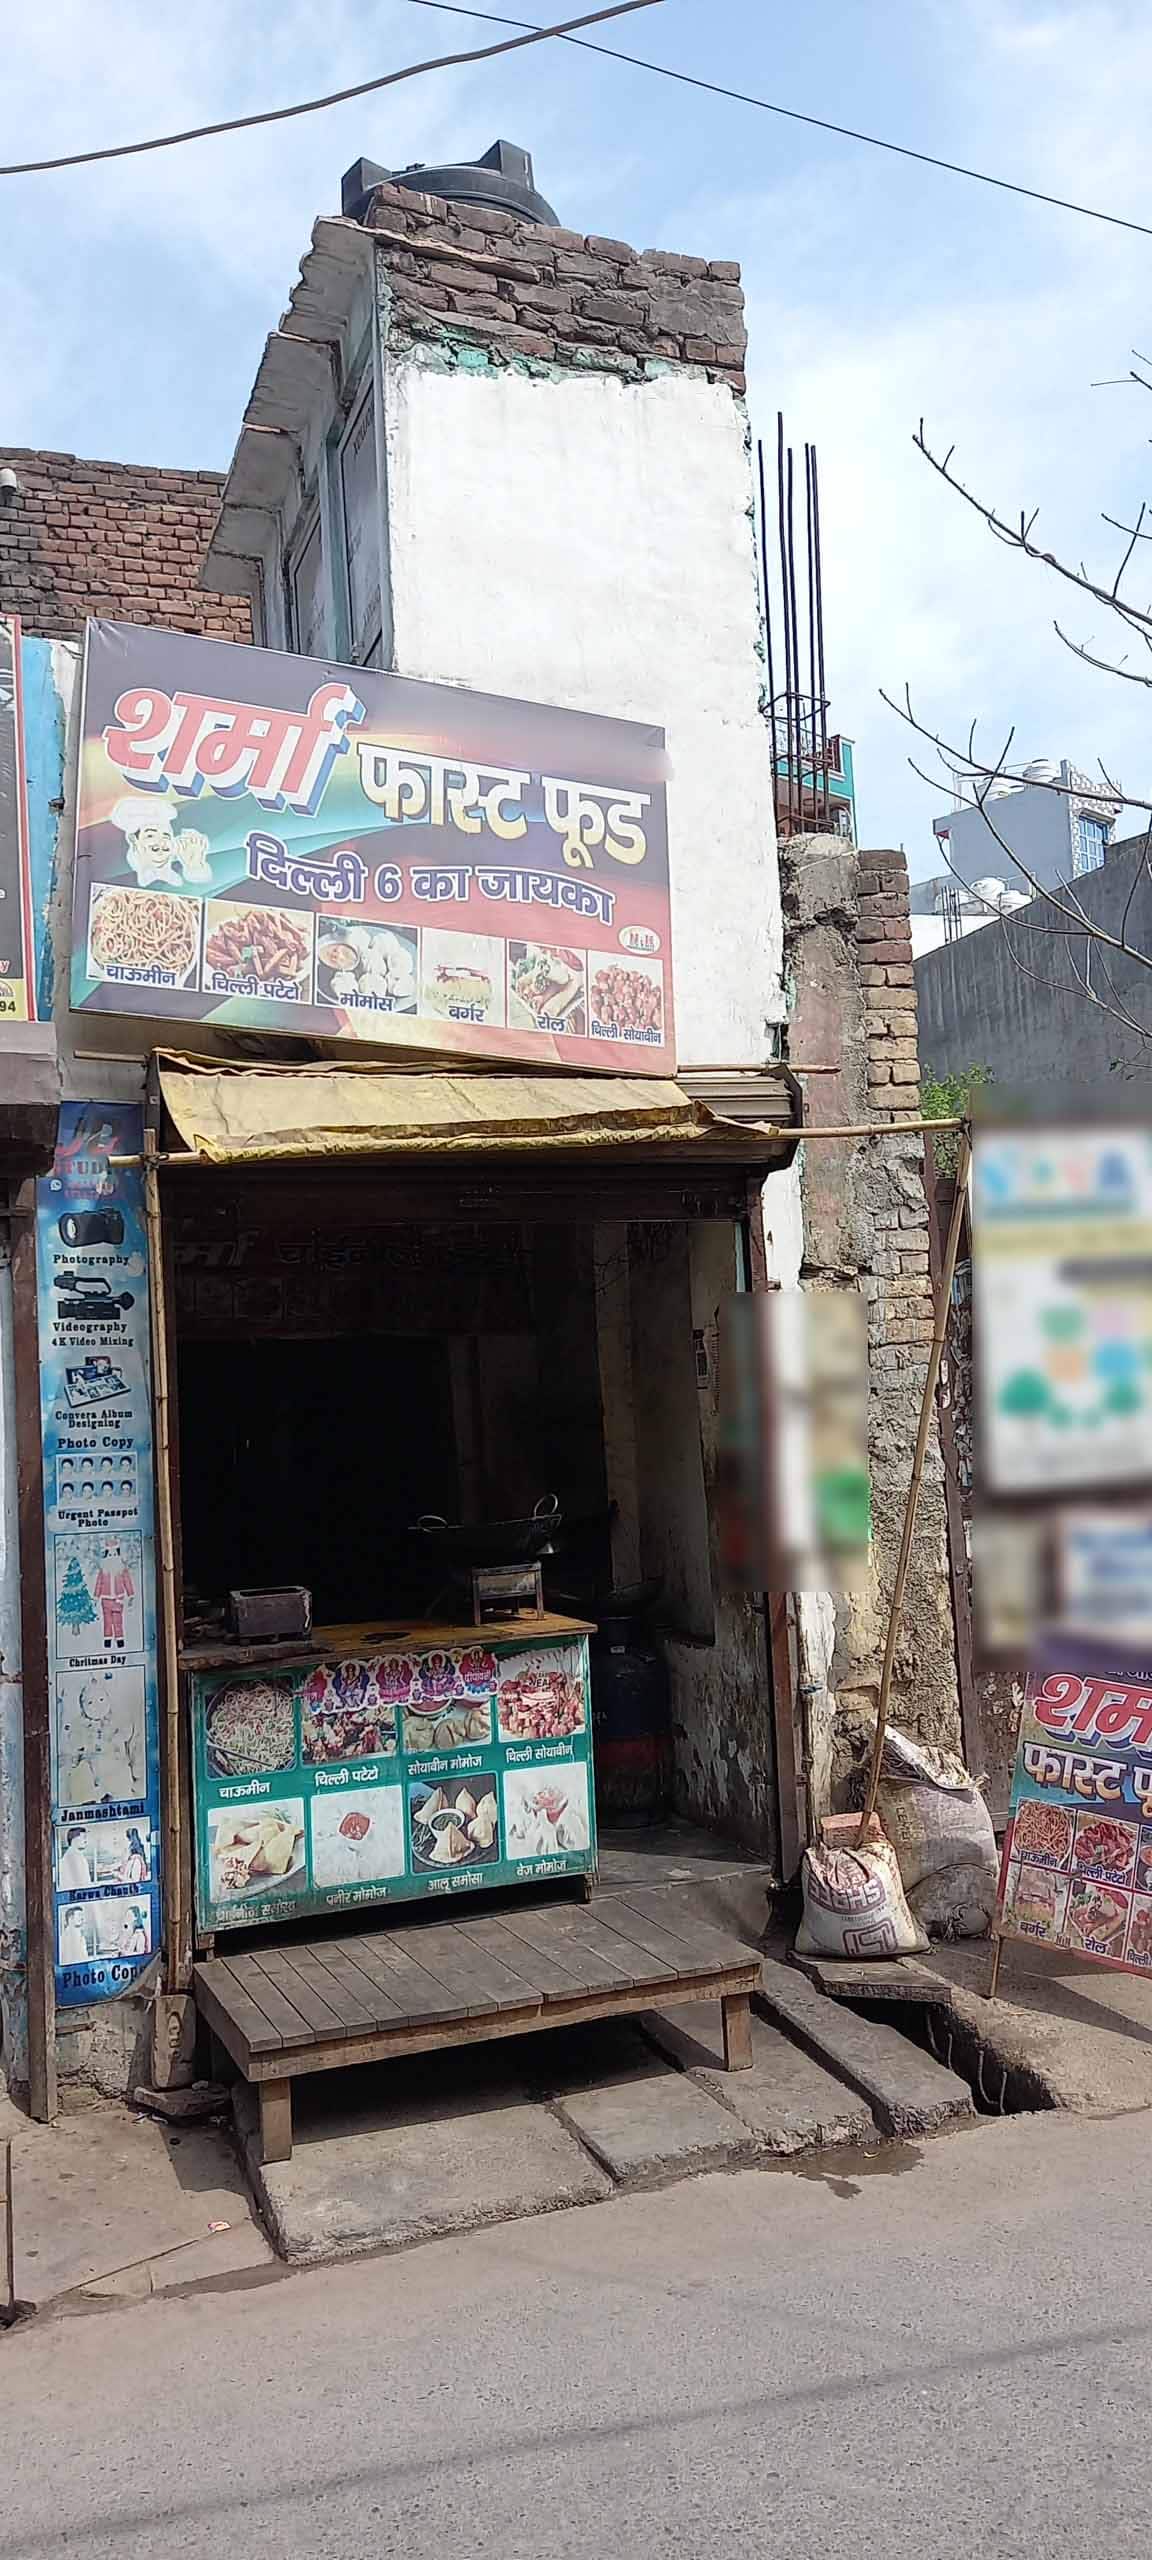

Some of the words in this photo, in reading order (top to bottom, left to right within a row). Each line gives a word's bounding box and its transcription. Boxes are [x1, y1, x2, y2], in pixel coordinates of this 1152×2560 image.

[102, 682, 365, 817] शर्मा
[357, 743, 532, 840] फास्ट
[541, 776, 651, 868] फूड
[247, 832, 367, 901] दिल्ली
[374, 865, 403, 902] 6
[411, 866, 471, 901] का
[477, 866, 614, 924] जायका
[106, 964, 176, 987] चाऊमीन
[211, 974, 259, 997] चिल्ली
[340, 991, 393, 1012] मोमोस
[537, 1013, 566, 1032] रोल
[591, 1021, 618, 1039] चिल्ली
[53, 1254, 129, 1267] Photography
[53, 1321, 128, 1334] Videography
[69, 1337, 97, 1347] Video
[100, 1336, 134, 1348] Mixing
[101, 1408, 133, 1419] Album
[68, 1419, 121, 1430] Designing
[57, 1437, 97, 1449] Photo
[102, 1435, 135, 1450] Copy
[57, 1509, 94, 1521] Urgent
[78, 1518, 109, 1528] Photo
[110, 1655, 127, 1666] Day
[506, 1744, 533, 1763] चिल्ली
[314, 1768, 349, 1788] चिल्ली
[1023, 1740, 1128, 1801] फास्ट
[218, 1779, 271, 1800] चाऊमीन
[60, 1802, 145, 1823] Janmashtami
[427, 1876, 450, 1893] आलू
[451, 1870, 483, 1889] समोसा
[62, 1966, 105, 1989] Photo
